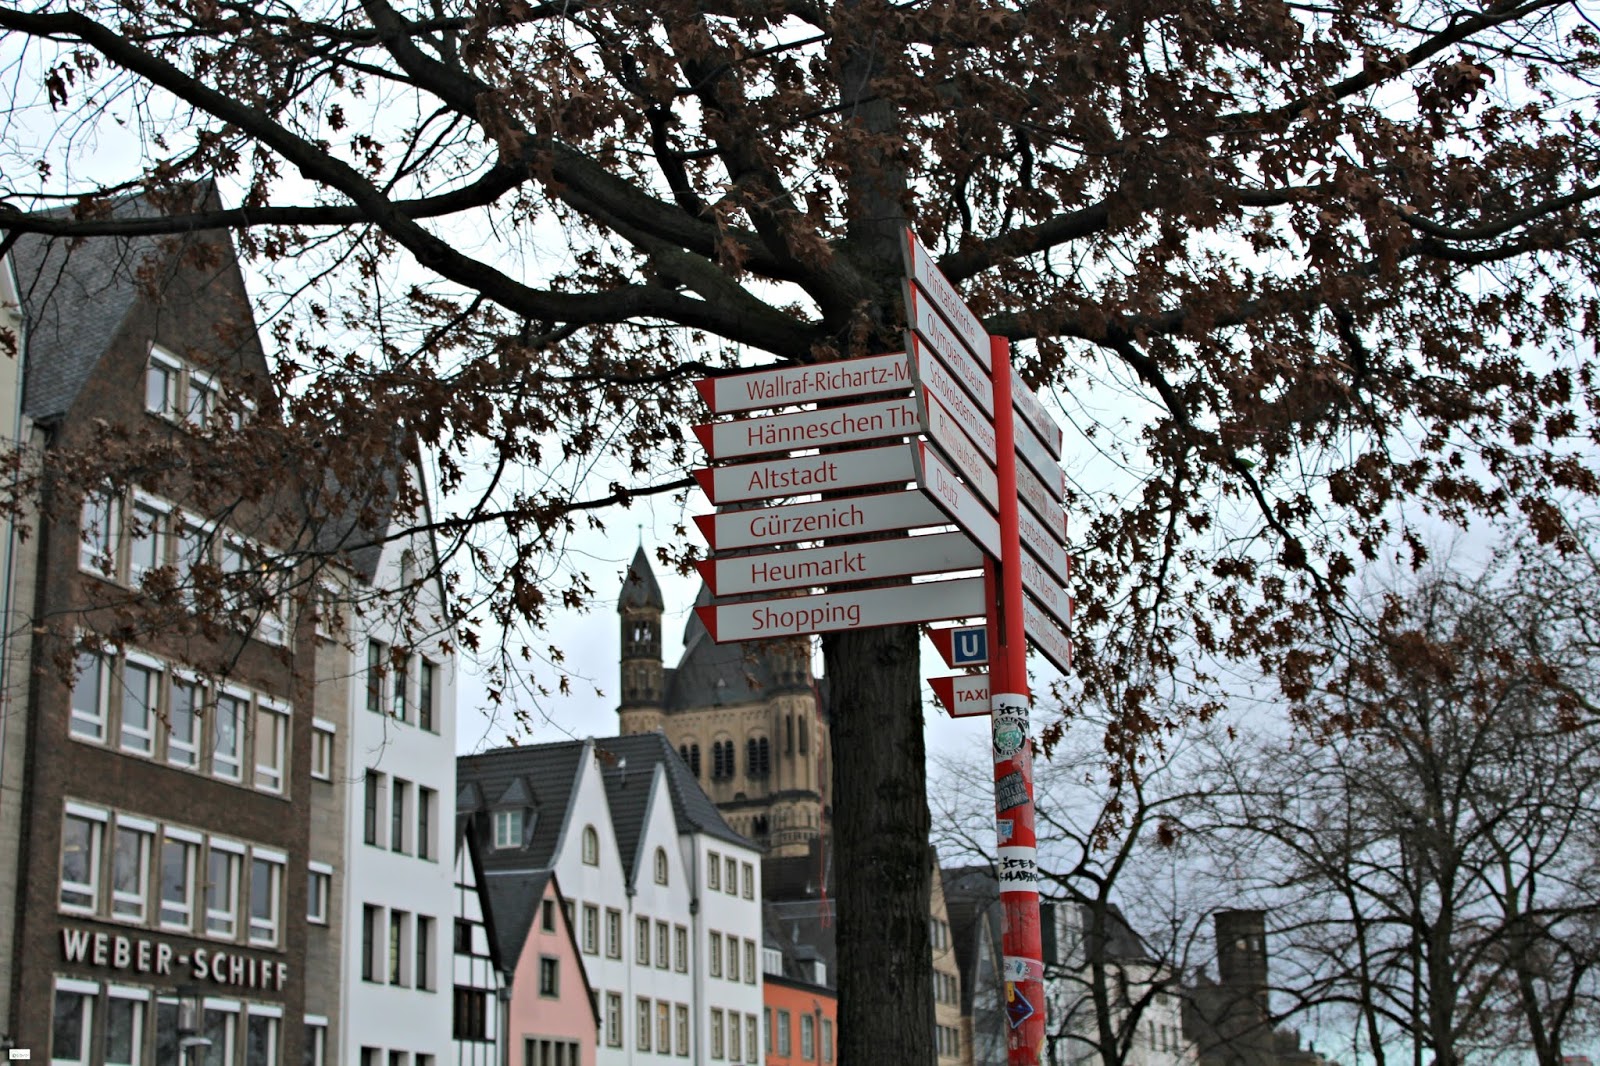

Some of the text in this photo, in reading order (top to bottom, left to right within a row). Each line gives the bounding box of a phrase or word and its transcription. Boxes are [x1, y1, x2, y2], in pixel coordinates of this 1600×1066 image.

[925, 261, 975, 343] Trinitatiskirche
[928, 314, 985, 399] Olympiamuseum
[930, 361, 995, 448] Schokoladenmuseum
[748, 412, 883, 447] Hänneschen
[939, 414, 983, 486] Rheinauhafen
[748, 461, 838, 491] Altstadt
[936, 468, 959, 510] Deutz
[750, 504, 864, 537] Gürzenich
[1020, 514, 1054, 562] auptbahnhof
[751, 551, 866, 583] Heumarkt
[752, 602, 860, 631] Shopping
[961, 634, 978, 657] U
[956, 689, 988, 702] TAXI
[62, 927, 287, 991] WEBER-SCHIFF
